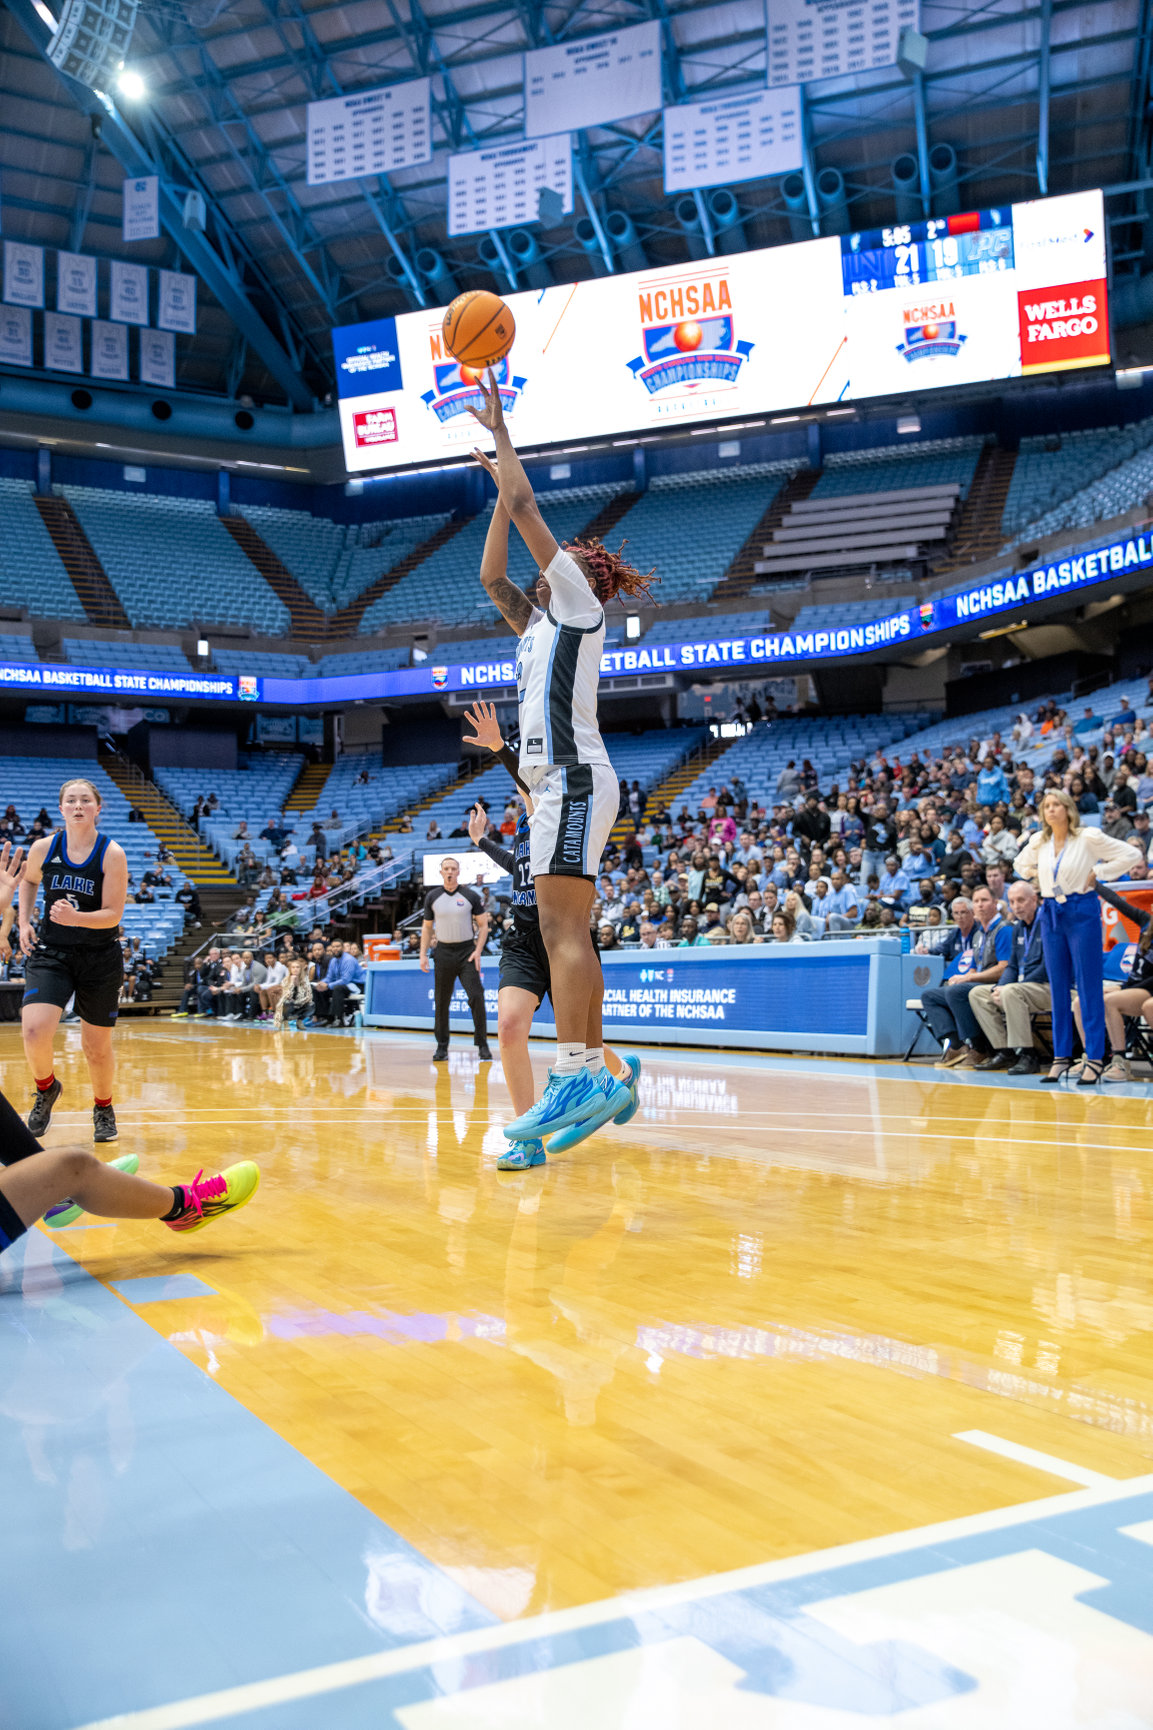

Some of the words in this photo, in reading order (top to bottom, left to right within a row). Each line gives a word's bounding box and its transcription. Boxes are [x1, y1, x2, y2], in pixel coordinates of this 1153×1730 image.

[895, 243, 919, 274] 21
[932, 237, 959, 267] 19
[639, 280, 732, 323] NCHSAA
[903, 302, 956, 324] NCHSAA
[1024, 295, 1097, 321] WELLS
[1027, 316, 1098, 342] FARGO
[645, 361, 738, 393] CHAMPIONSHIPS
[956, 576, 1030, 618] NCHSAA
[1033, 536, 1153, 594] BASKETBAL
[461, 663, 517, 685] NCHS
[600, 648, 676, 672] ETBALL
[681, 641, 745, 665] STATE
[750, 615, 910, 658] CHAMPIONSHIPS
[0, 668, 42, 683] NCHSAA
[42, 670, 113, 687] BASKETBALL
[114, 675, 147, 689] STATE
[148, 677, 233, 694] CHAMPIONSHIPS
[563, 801, 587, 864] CATAMOUNTS
[515, 840, 531, 862] LAK
[51, 875, 94, 896] LAKE
[1102, 901, 1119, 925] G
[629, 989, 668, 1003] HEALTH
[670, 989, 736, 1004] INSURANCE
[602, 1004, 637, 1017] ARTNER
[638, 1004, 653, 1017] OF
[655, 1004, 674, 1018] THE
[676, 1005, 725, 1020] NCHSAA
